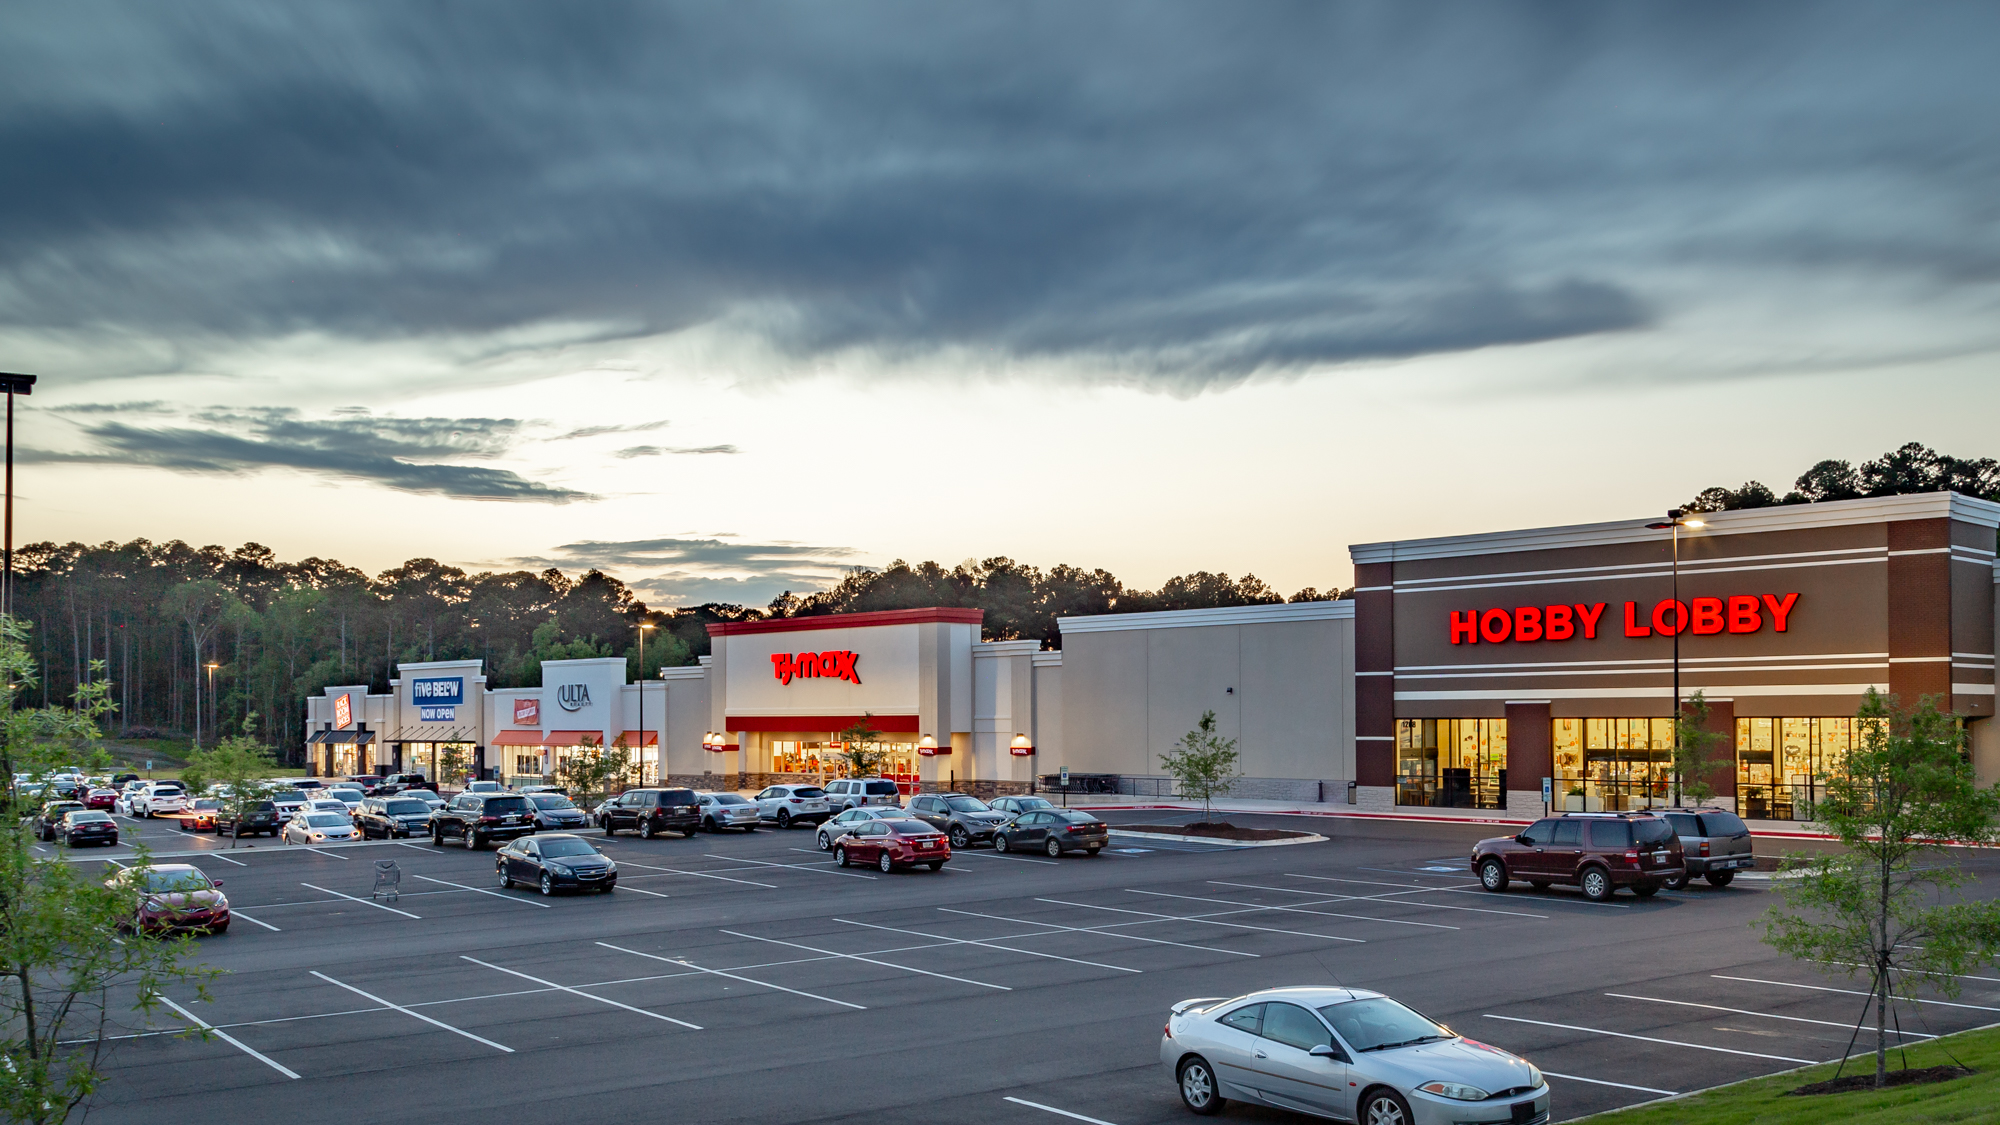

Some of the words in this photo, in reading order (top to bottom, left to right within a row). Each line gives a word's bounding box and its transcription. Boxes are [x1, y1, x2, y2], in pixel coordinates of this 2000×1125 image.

[1450, 603, 1607, 644] HOBBY
[1624, 593, 1800, 638] LOBBY
[415, 681, 432, 698] five
[562, 683, 591, 702] ULTA
[421, 708, 436, 719] NOW
